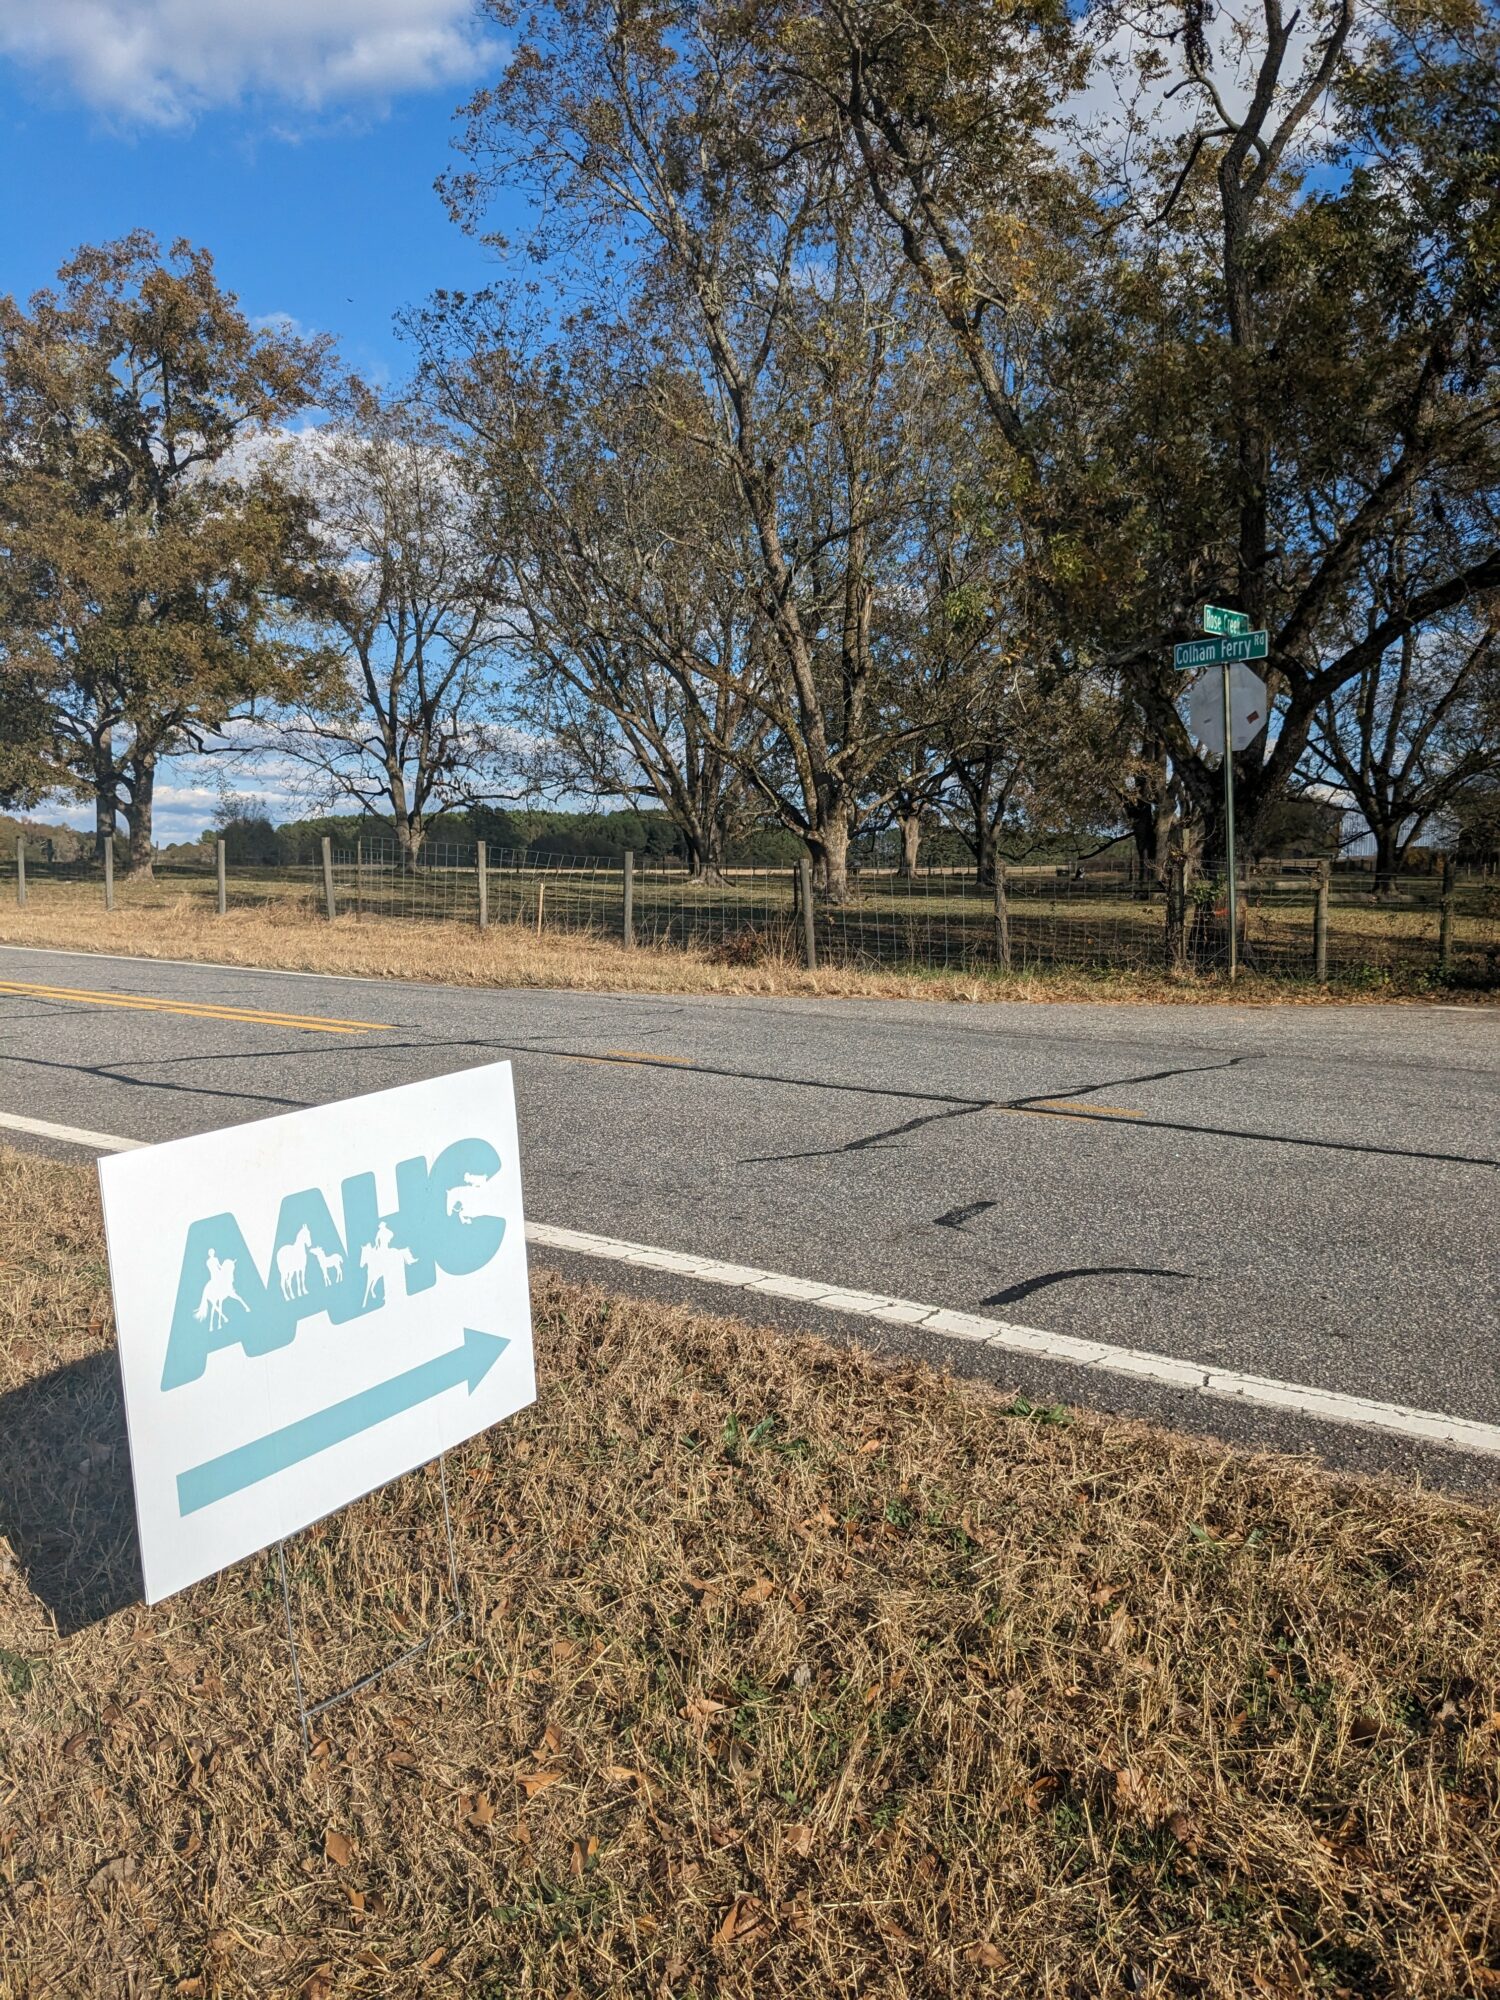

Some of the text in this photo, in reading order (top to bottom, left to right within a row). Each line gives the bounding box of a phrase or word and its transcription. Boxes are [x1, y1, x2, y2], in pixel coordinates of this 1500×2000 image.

[1176, 634, 1264, 664] Colham Ferry Rd
[160, 1137, 507, 1392] AAHC
